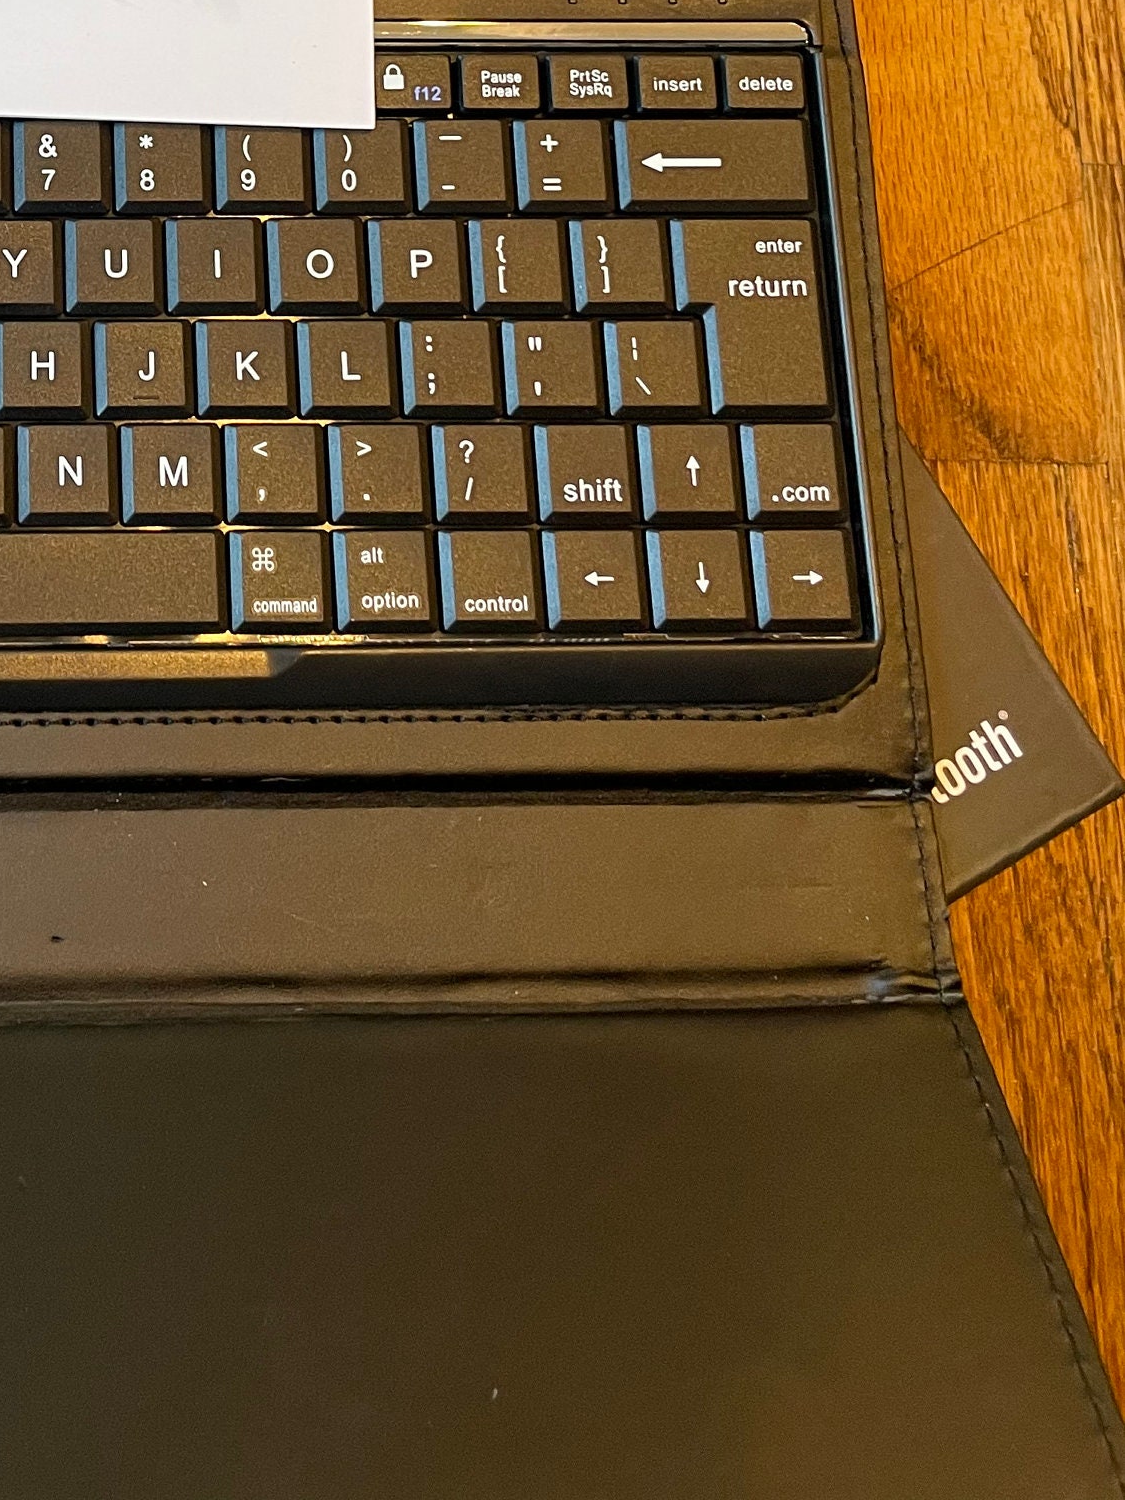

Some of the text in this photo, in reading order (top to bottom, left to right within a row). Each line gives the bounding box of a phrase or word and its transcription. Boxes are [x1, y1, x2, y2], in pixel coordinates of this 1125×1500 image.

[481, 71, 521, 87] Pause
[570, 70, 608, 86] PrtSc
[654, 77, 702, 91] insert
[739, 77, 792, 90] delete
[415, 87, 441, 100] f12
[482, 85, 519, 97] Break
[570, 83, 612, 98] SysRq
[42, 170, 55, 190] 7
[140, 169, 154, 190] 8
[241, 169, 255, 190] 9
[756, 239, 802, 253] enter
[3, 250, 27, 277] Y
[105, 250, 127, 278] U
[307, 250, 333, 278] O
[410, 250, 432, 278] P
[729, 276, 807, 296] return
[32, 351, 54, 380] H
[139, 352, 154, 380] J
[236, 352, 260, 380] K
[341, 352, 361, 380] L
[59, 456, 82, 485] N
[160, 457, 187, 486] M
[564, 478, 622, 501] shift
[772, 486, 829, 502] .com
[361, 547, 383, 563] alt
[254, 598, 317, 613] command
[362, 592, 418, 612] option
[465, 595, 528, 612] control
